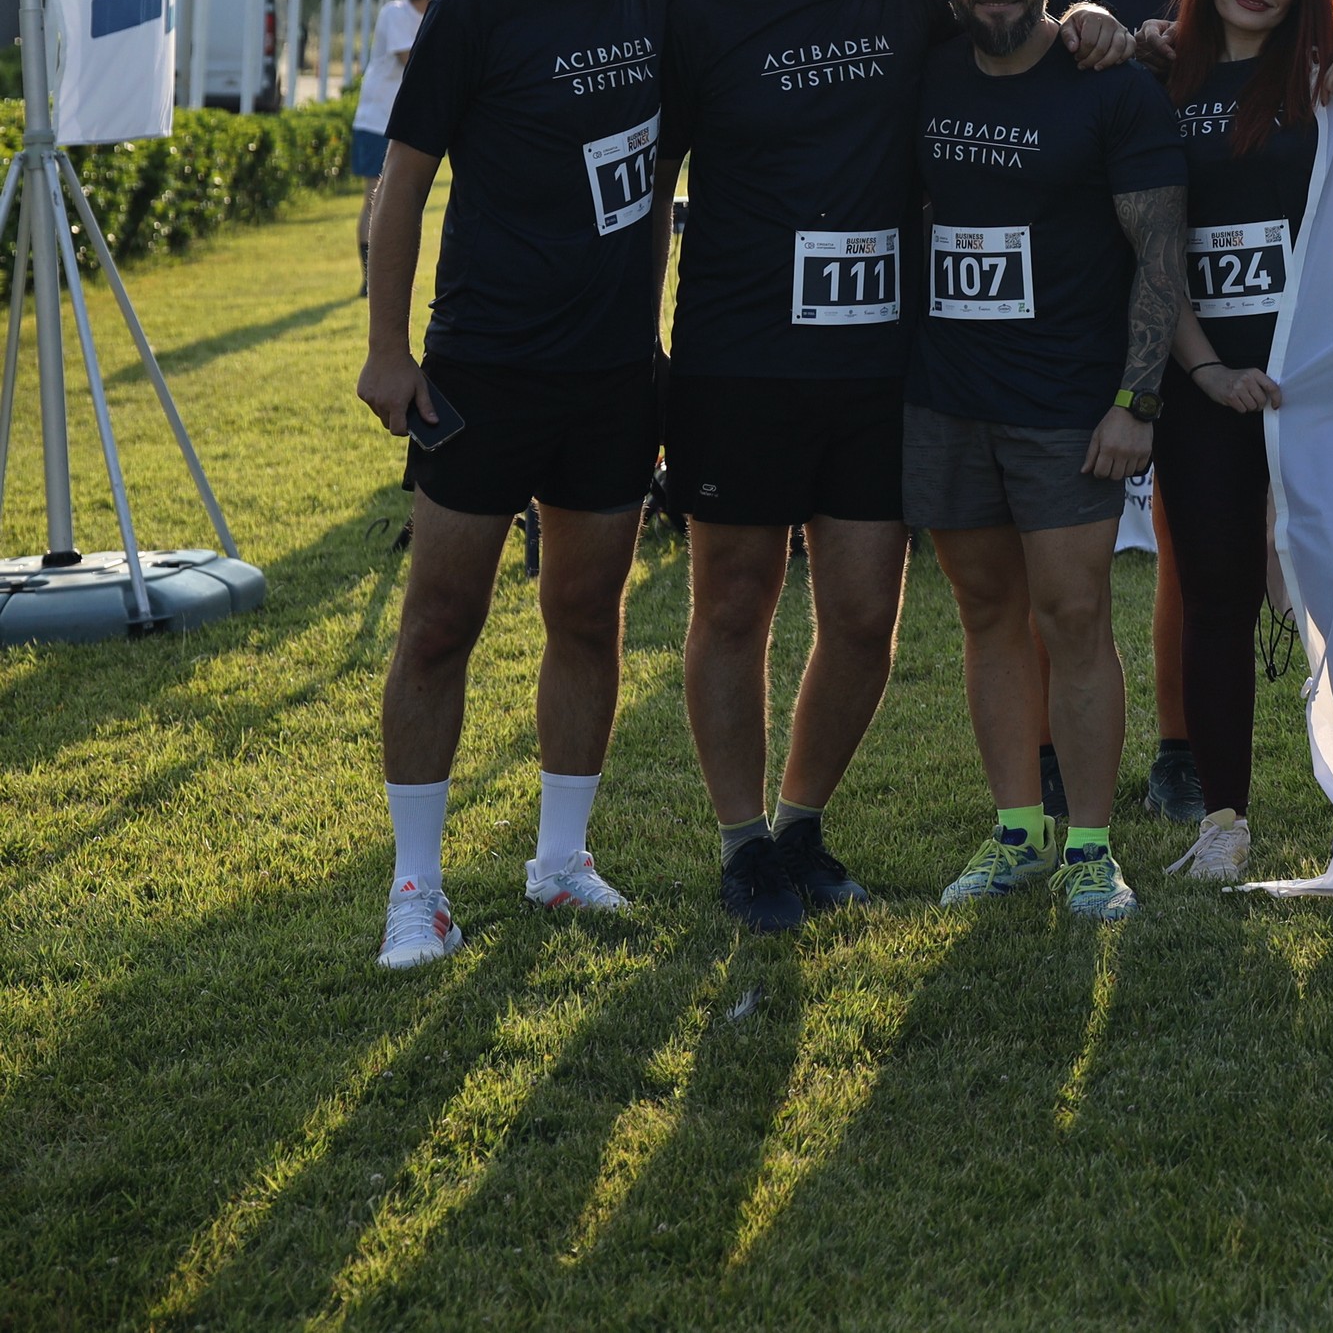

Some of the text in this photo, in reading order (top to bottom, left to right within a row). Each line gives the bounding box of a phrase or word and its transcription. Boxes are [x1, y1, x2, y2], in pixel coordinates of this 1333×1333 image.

[763, 35, 890, 70] ACIBADEM
[572, 63, 654, 95] SISTINA
[780, 60, 885, 91] SISTINA
[926, 117, 1040, 146] ACIBADEM
[933, 142, 1023, 168] SISTINA
[1211, 230, 1244, 239] BUSINESS
[822, 259, 885, 302] 111
[943, 256, 1007, 297] 107
[1198, 251, 1272, 295] 124
